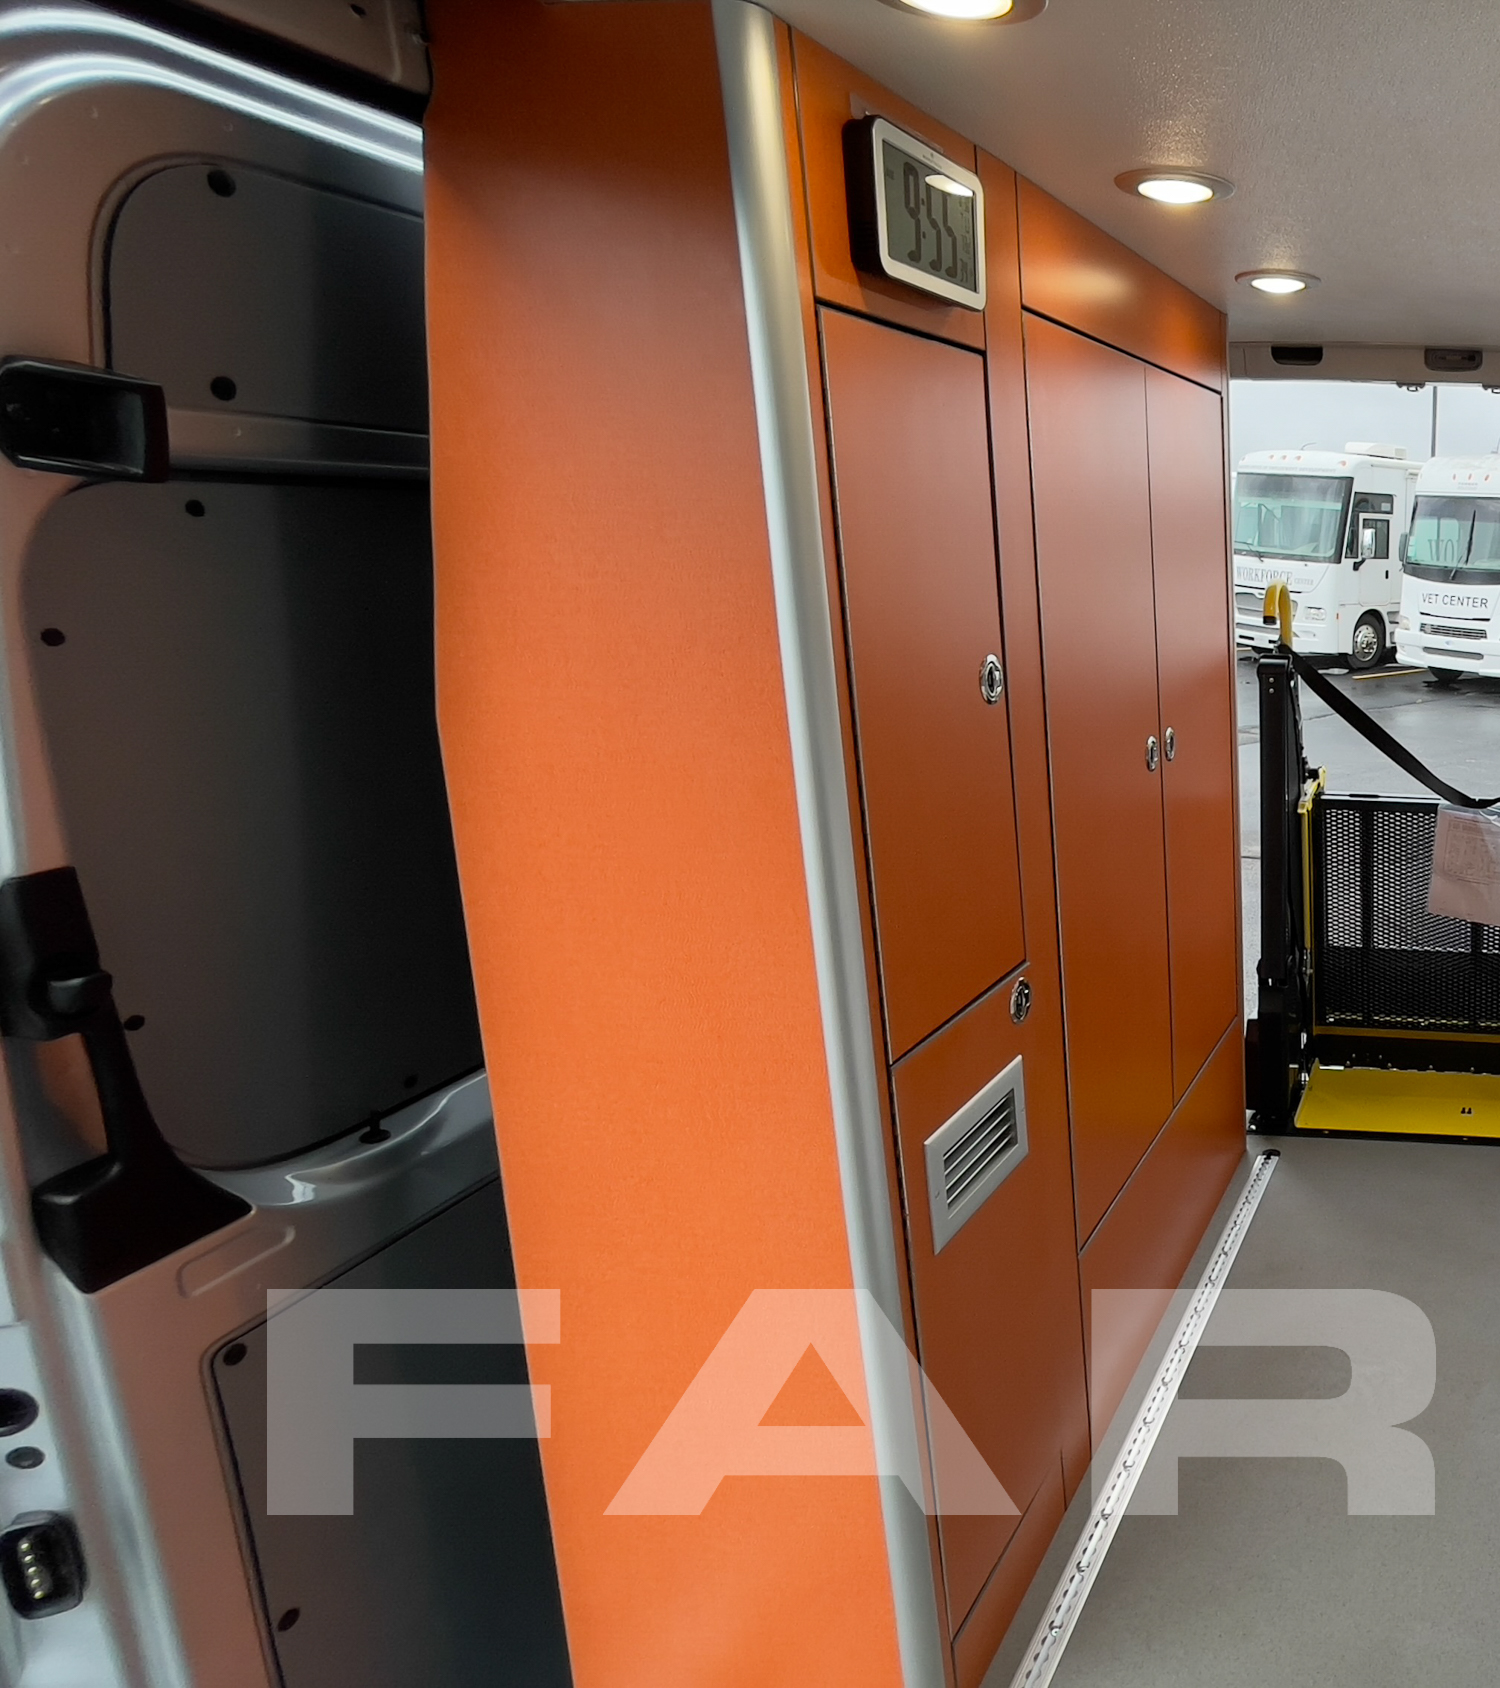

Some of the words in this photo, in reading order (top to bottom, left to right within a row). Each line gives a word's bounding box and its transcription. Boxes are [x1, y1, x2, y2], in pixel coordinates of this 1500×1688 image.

[1236, 566, 1293, 586] WORKFORCE
[1422, 593, 1439, 604] VET
[1442, 594, 1489, 609] CENTER
